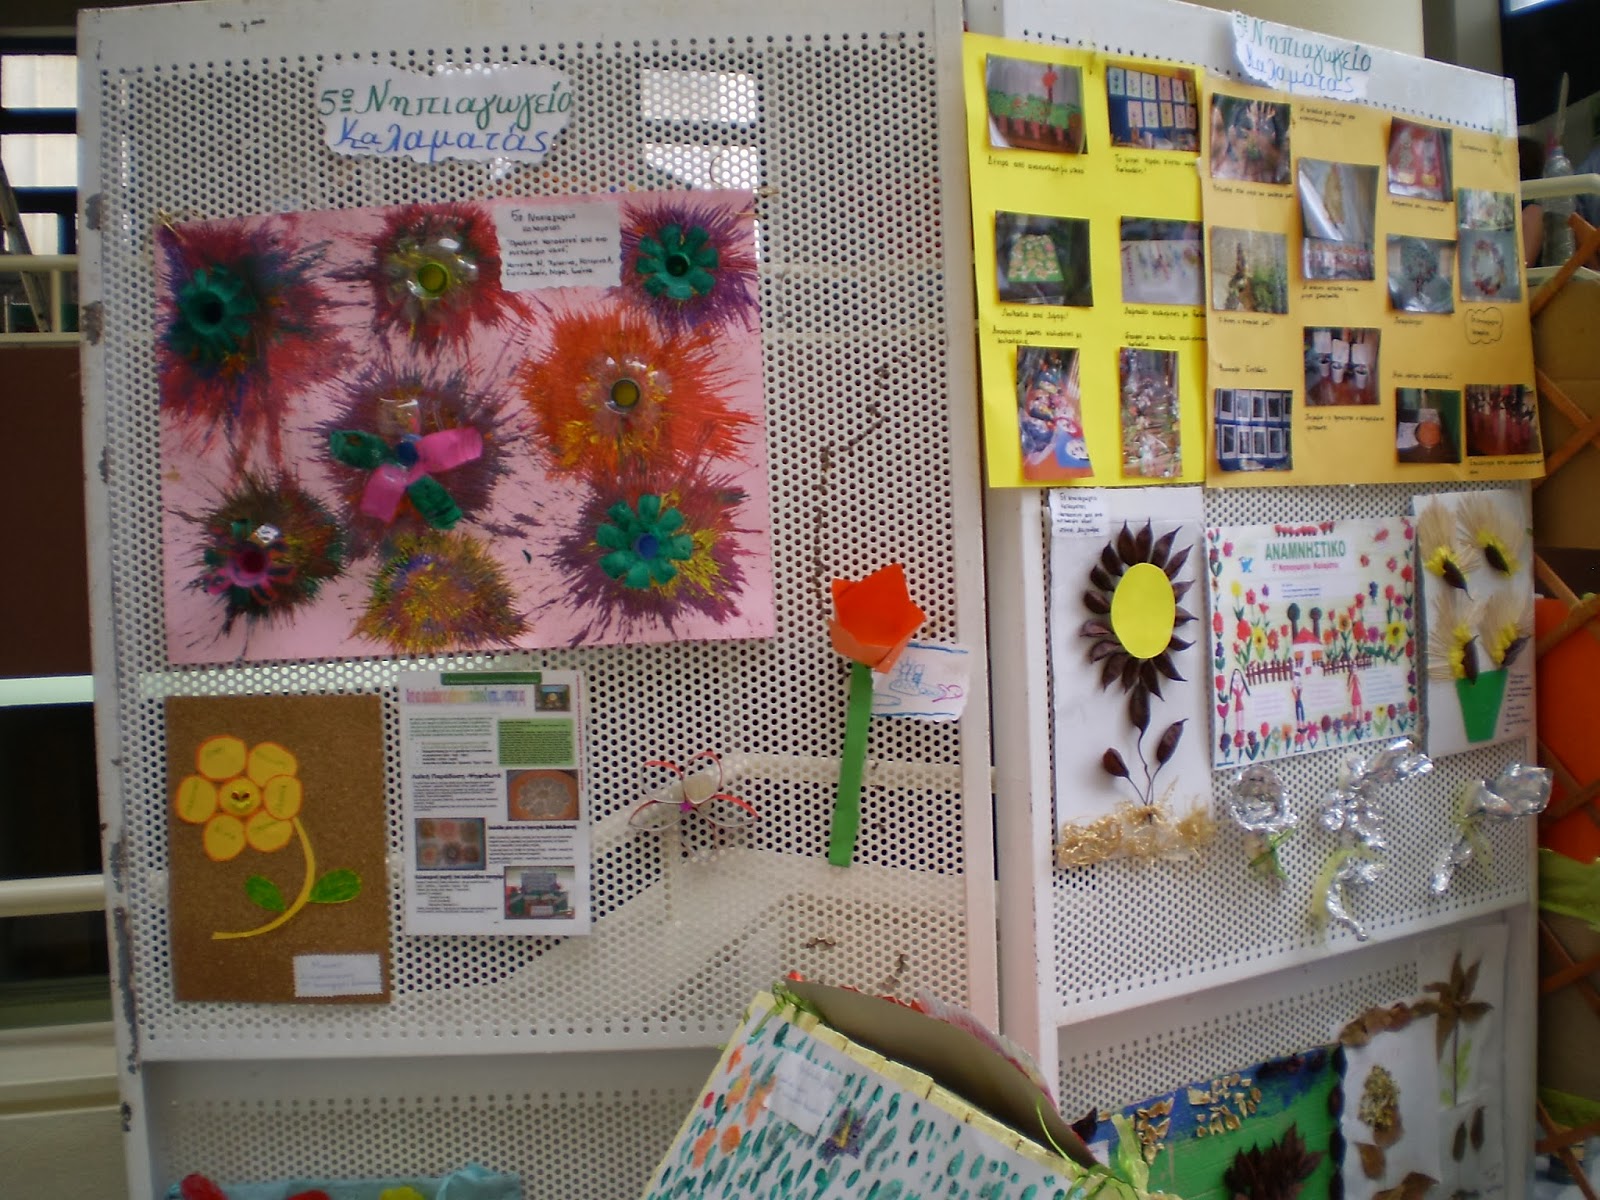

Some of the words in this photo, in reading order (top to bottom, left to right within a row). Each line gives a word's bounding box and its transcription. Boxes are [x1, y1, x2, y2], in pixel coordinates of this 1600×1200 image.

[1250, 19, 1372, 82] Νηπιαγωγείο
[354, 79, 573, 131] Νηπιαγωγείο
[1265, 540, 1346, 561] ΑΝΑΜΝΗΣΤΙΚΟ
